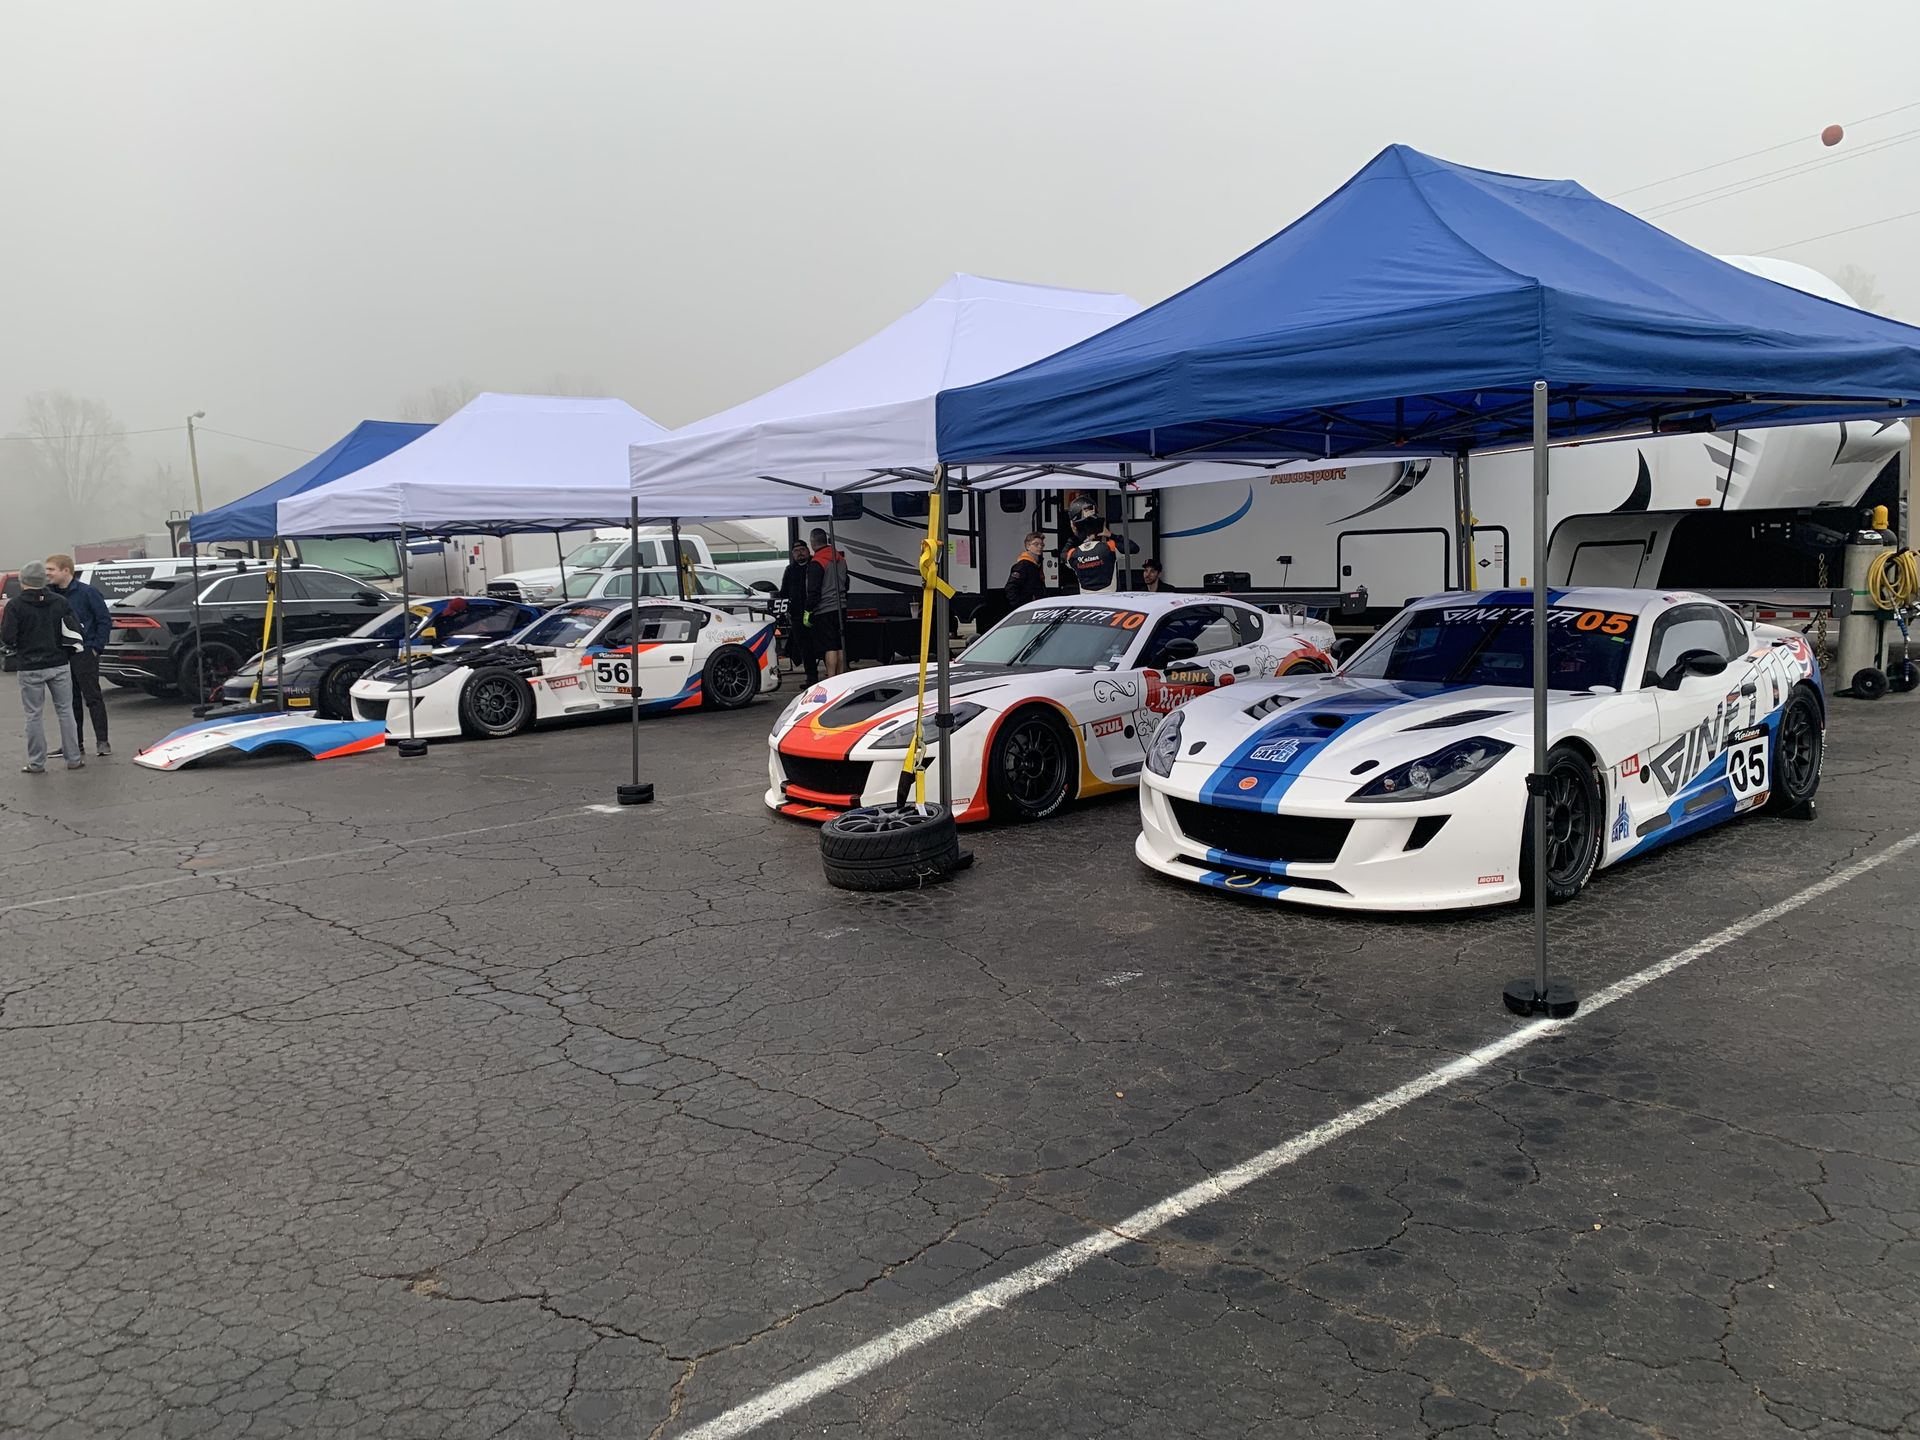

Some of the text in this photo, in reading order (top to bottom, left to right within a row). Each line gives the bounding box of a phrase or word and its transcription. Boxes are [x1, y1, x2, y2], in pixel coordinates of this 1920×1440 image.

[1270, 467, 1346, 485] Autosport
[772, 599, 789, 614] 56
[1109, 611, 1146, 630] 10
[1576, 610, 1634, 635] 05
[597, 662, 630, 684] 56
[1171, 671, 1209, 683] DRINK
[1729, 744, 1765, 792] 05
